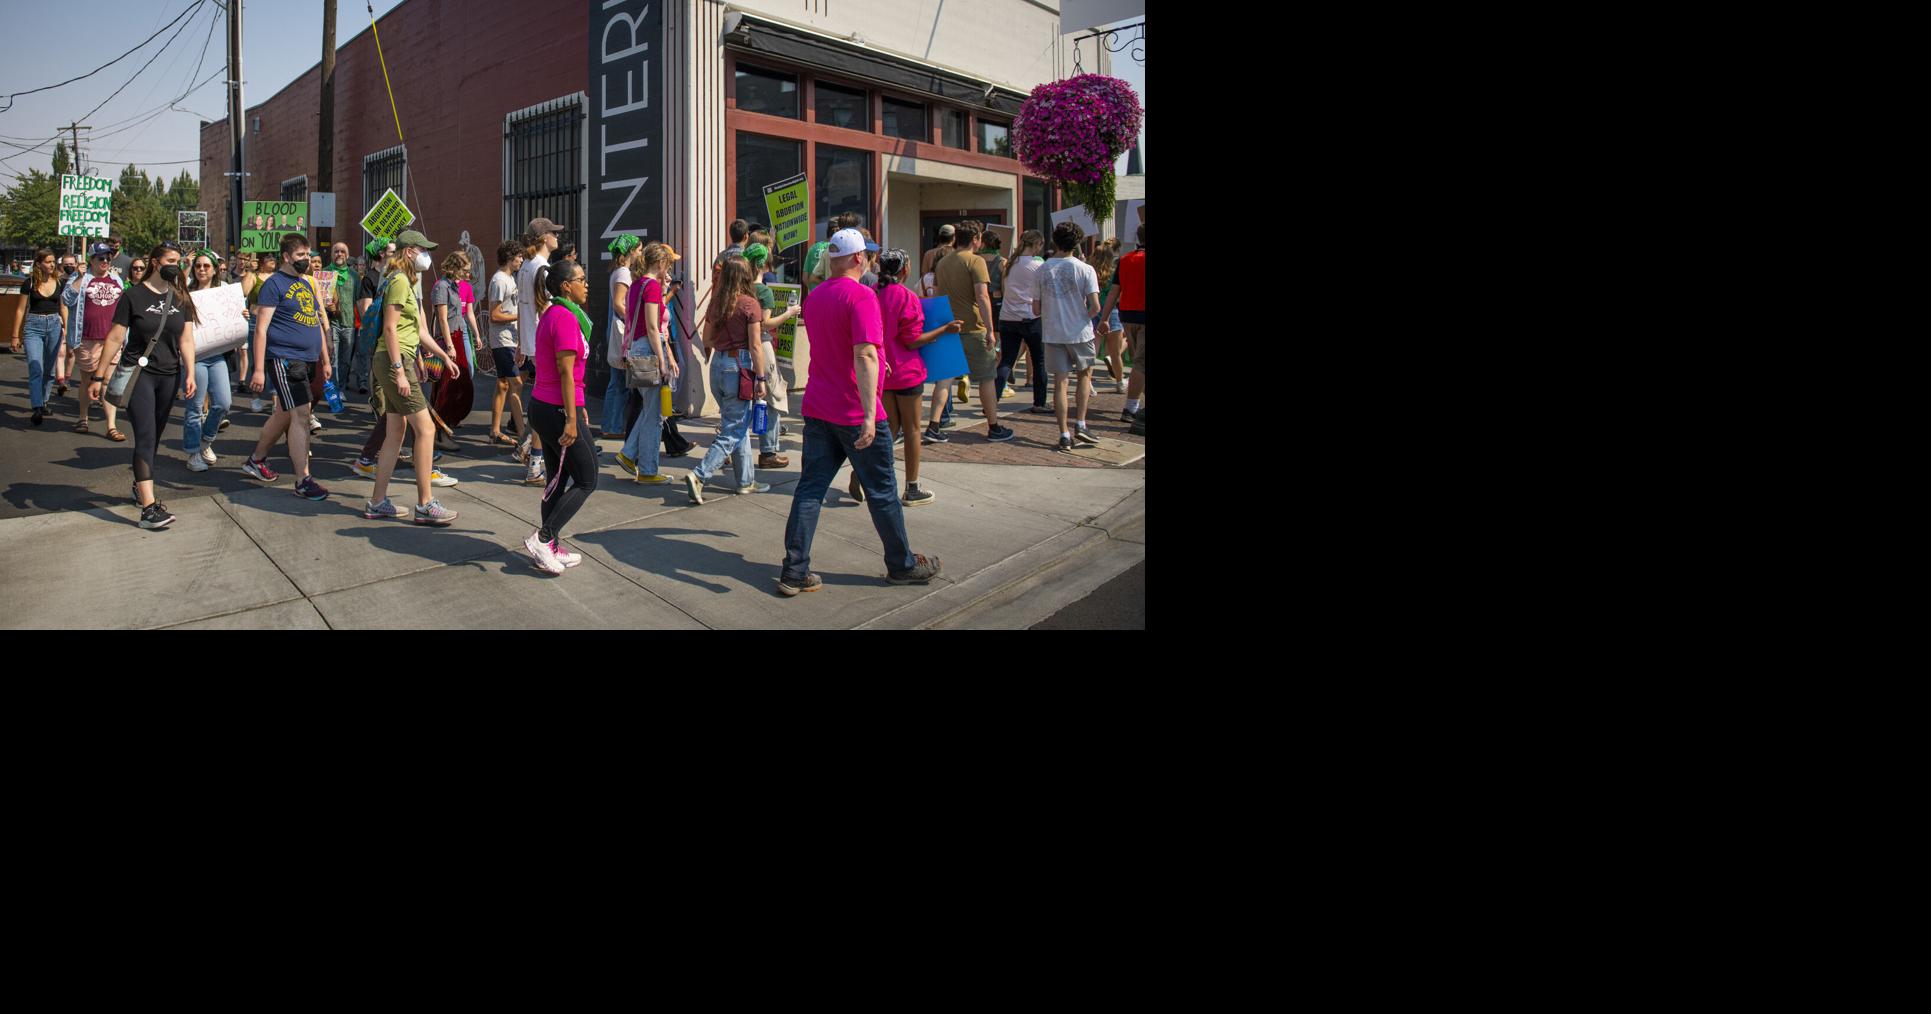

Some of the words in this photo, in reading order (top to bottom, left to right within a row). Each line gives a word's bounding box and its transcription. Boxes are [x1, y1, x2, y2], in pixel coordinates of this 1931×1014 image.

[62, 175, 112, 193] FREEDOM
[63, 194, 112, 210] RELIGION
[778, 189, 798, 204] LEGAL
[60, 209, 109, 225] FREEDOM
[255, 201, 298, 216] BLOOD
[368, 196, 392, 226] ABORTION
[775, 201, 804, 219] ABORTION
[372, 225, 382, 236] ON
[379, 200, 400, 227] DEMAND
[384, 208, 405, 235] WITHOUT
[774, 211, 808, 233] NATIONWIDE
[60, 224, 103, 239] CHOICE
[241, 236, 256, 249] ON
